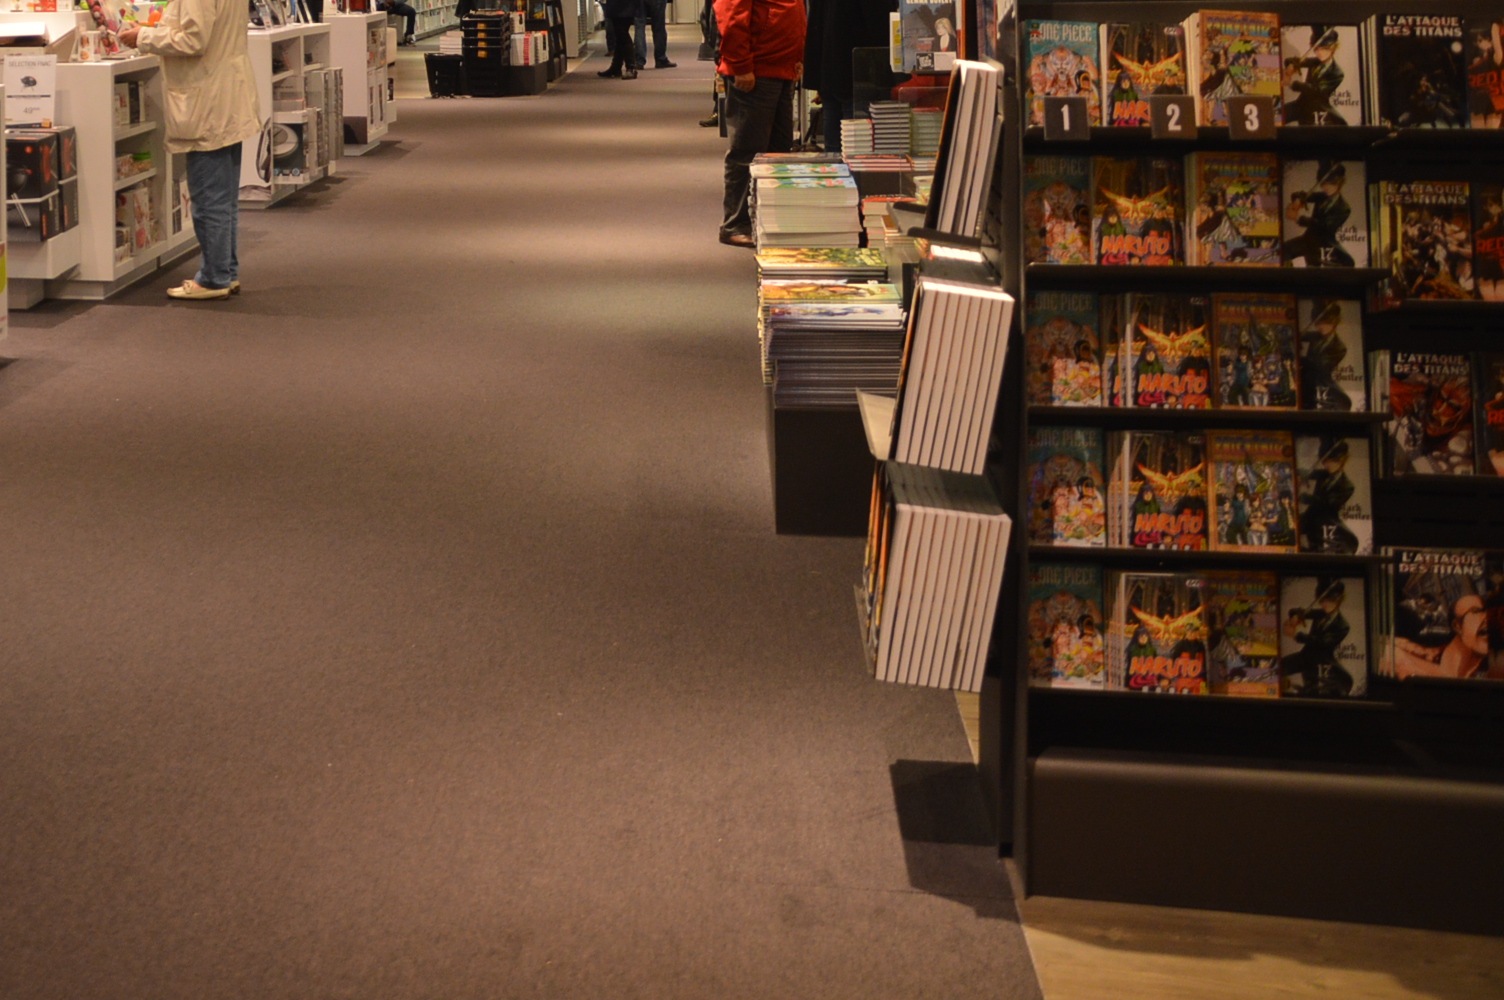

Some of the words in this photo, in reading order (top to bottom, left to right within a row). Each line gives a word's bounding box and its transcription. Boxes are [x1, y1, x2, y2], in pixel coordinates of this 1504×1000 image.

[1385, 15, 1459, 26] L'ATTAQUE
[1039, 22, 1060, 41] ONE
[1383, 26, 1411, 36] DES
[1414, 27, 1462, 37] TITANS
[1061, 104, 1070, 131] 1
[1166, 103, 1182, 131] 2
[1243, 103, 1259, 131] 3
[1312, 111, 1328, 125] 17
[1388, 184, 1463, 193] L'ATTAQUE
[1101, 235, 1170, 254] NARUTO
[1397, 352, 1464, 363] L'ATTAQUE
[1394, 363, 1420, 373] DES
[1424, 364, 1470, 375] TITANS
[1138, 373, 1207, 393] NARUTO
[1135, 513, 1204, 533] NARUTO
[1322, 524, 1336, 539] 17
[1402, 552, 1480, 563] L'ATTAQUE
[1399, 563, 1428, 573] DES
[1433, 564, 1483, 576] TITANS
[1129, 655, 1202, 677] NARUTO
[1317, 664, 1331, 678] 17
